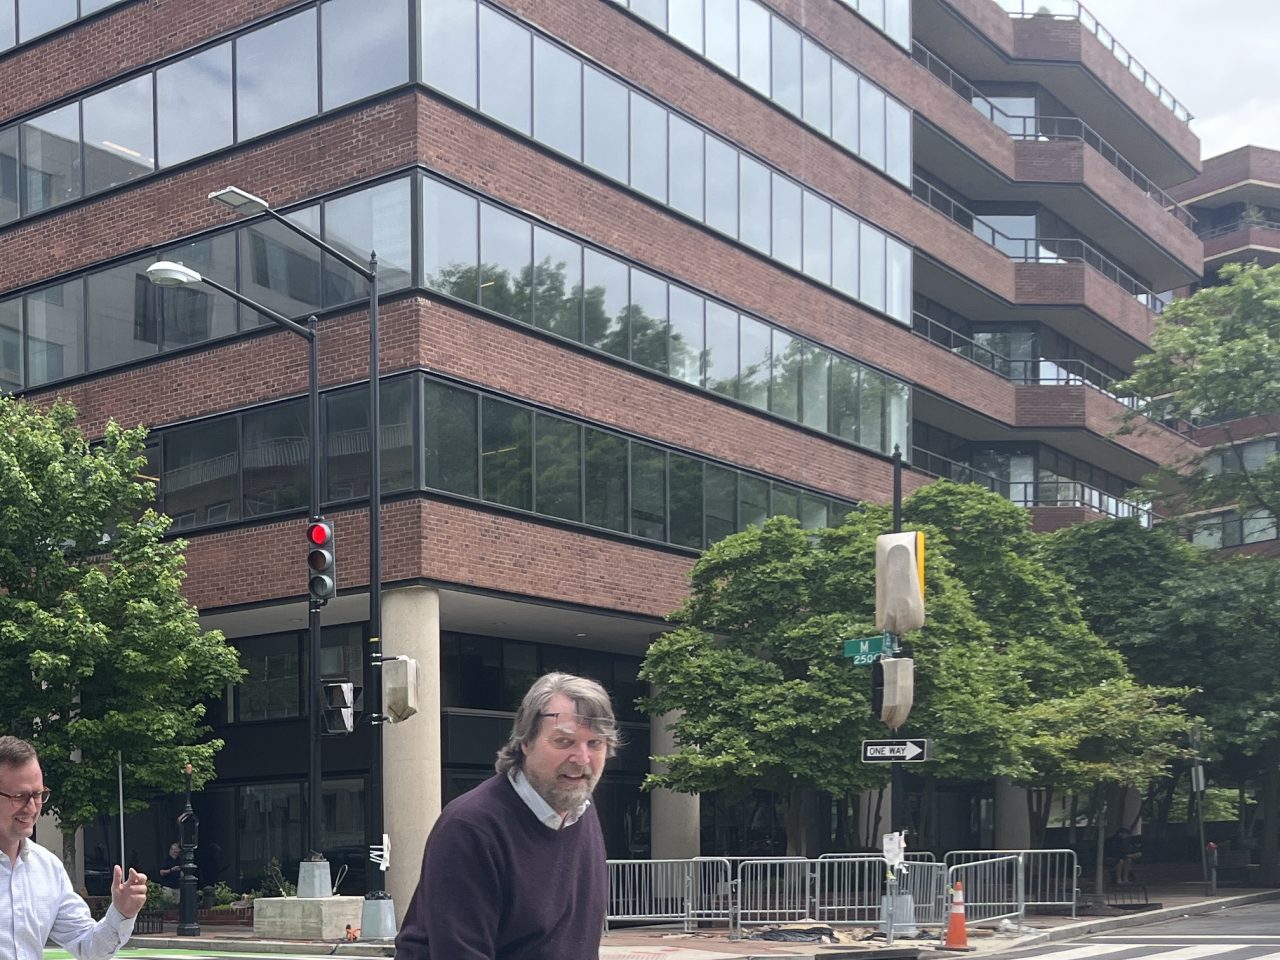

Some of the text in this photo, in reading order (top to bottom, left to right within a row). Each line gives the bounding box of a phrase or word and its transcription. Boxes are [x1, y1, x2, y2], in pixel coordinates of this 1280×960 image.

[860, 640, 869, 653] M
[869, 746, 907, 756] ONE WAY
